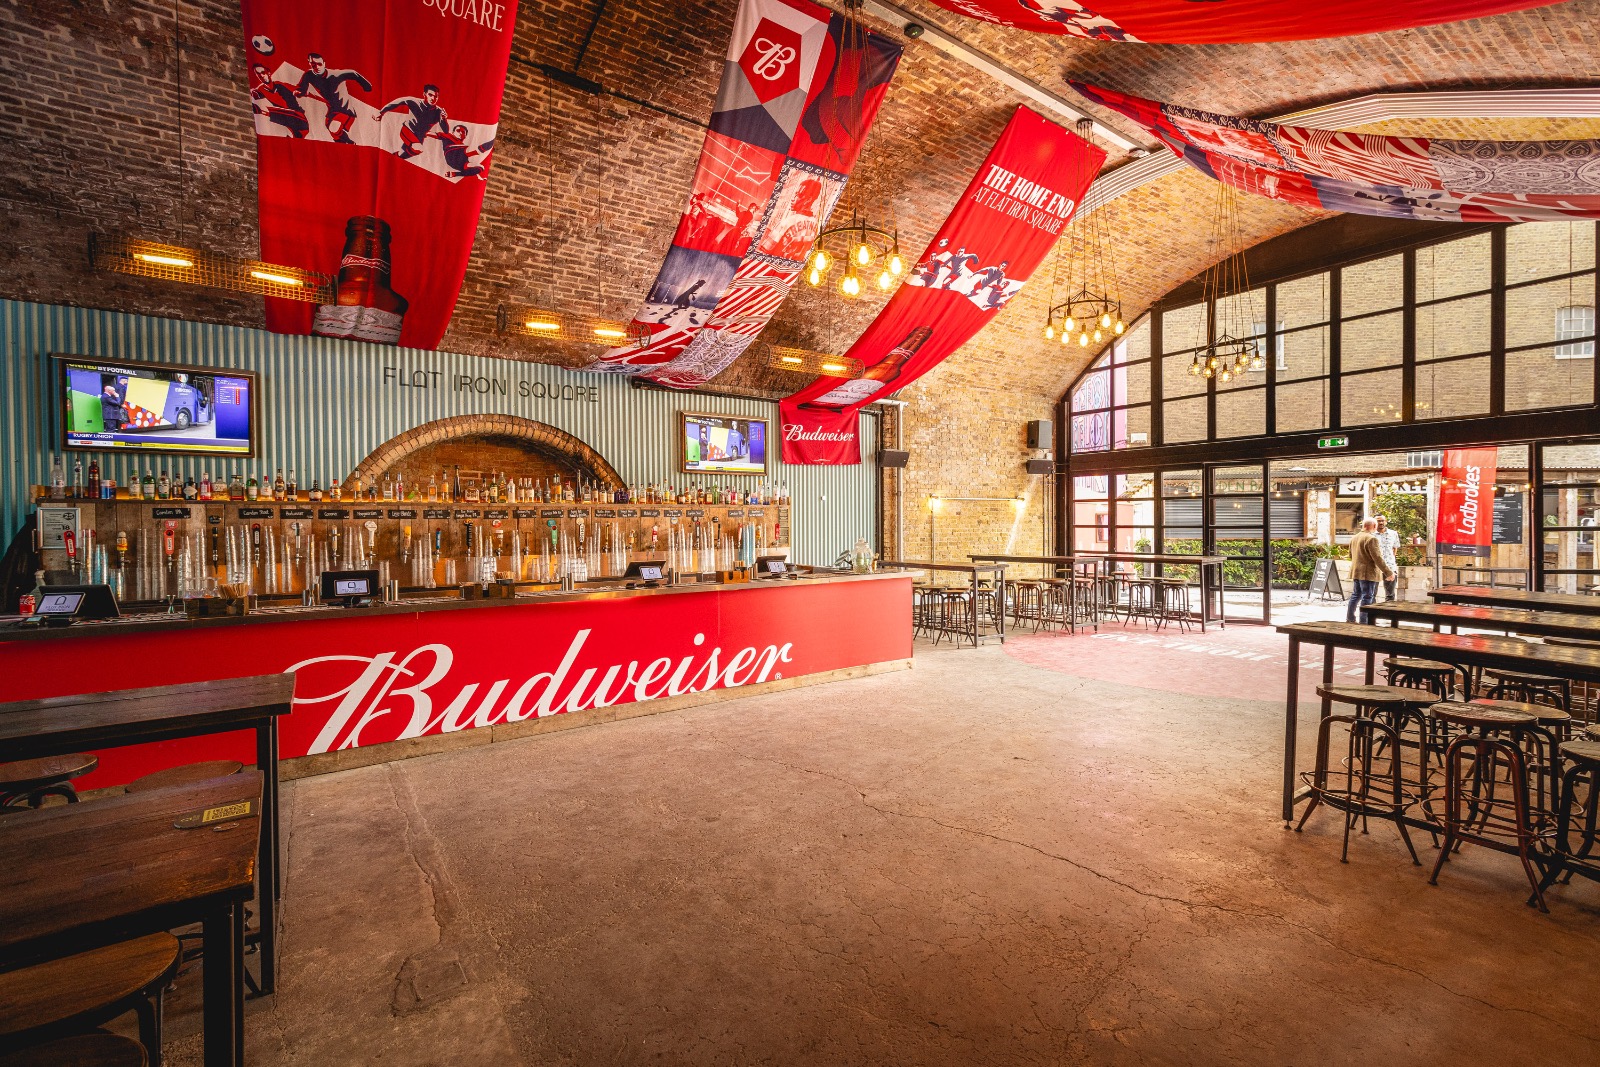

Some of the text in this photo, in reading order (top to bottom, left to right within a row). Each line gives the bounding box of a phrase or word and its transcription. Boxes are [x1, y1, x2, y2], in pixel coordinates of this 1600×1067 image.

[970, 186, 1064, 235] AT FLAT IRON SQUARE
[982, 163, 1075, 219] THE HOME END
[107, 366, 137, 376] FOOTBALL
[383, 367, 599, 403] FLAT IRON SQUARE
[783, 424, 855, 442] Budweiser
[1456, 464, 1481, 535] Ladbrokes
[286, 629, 793, 755] Budweiser
